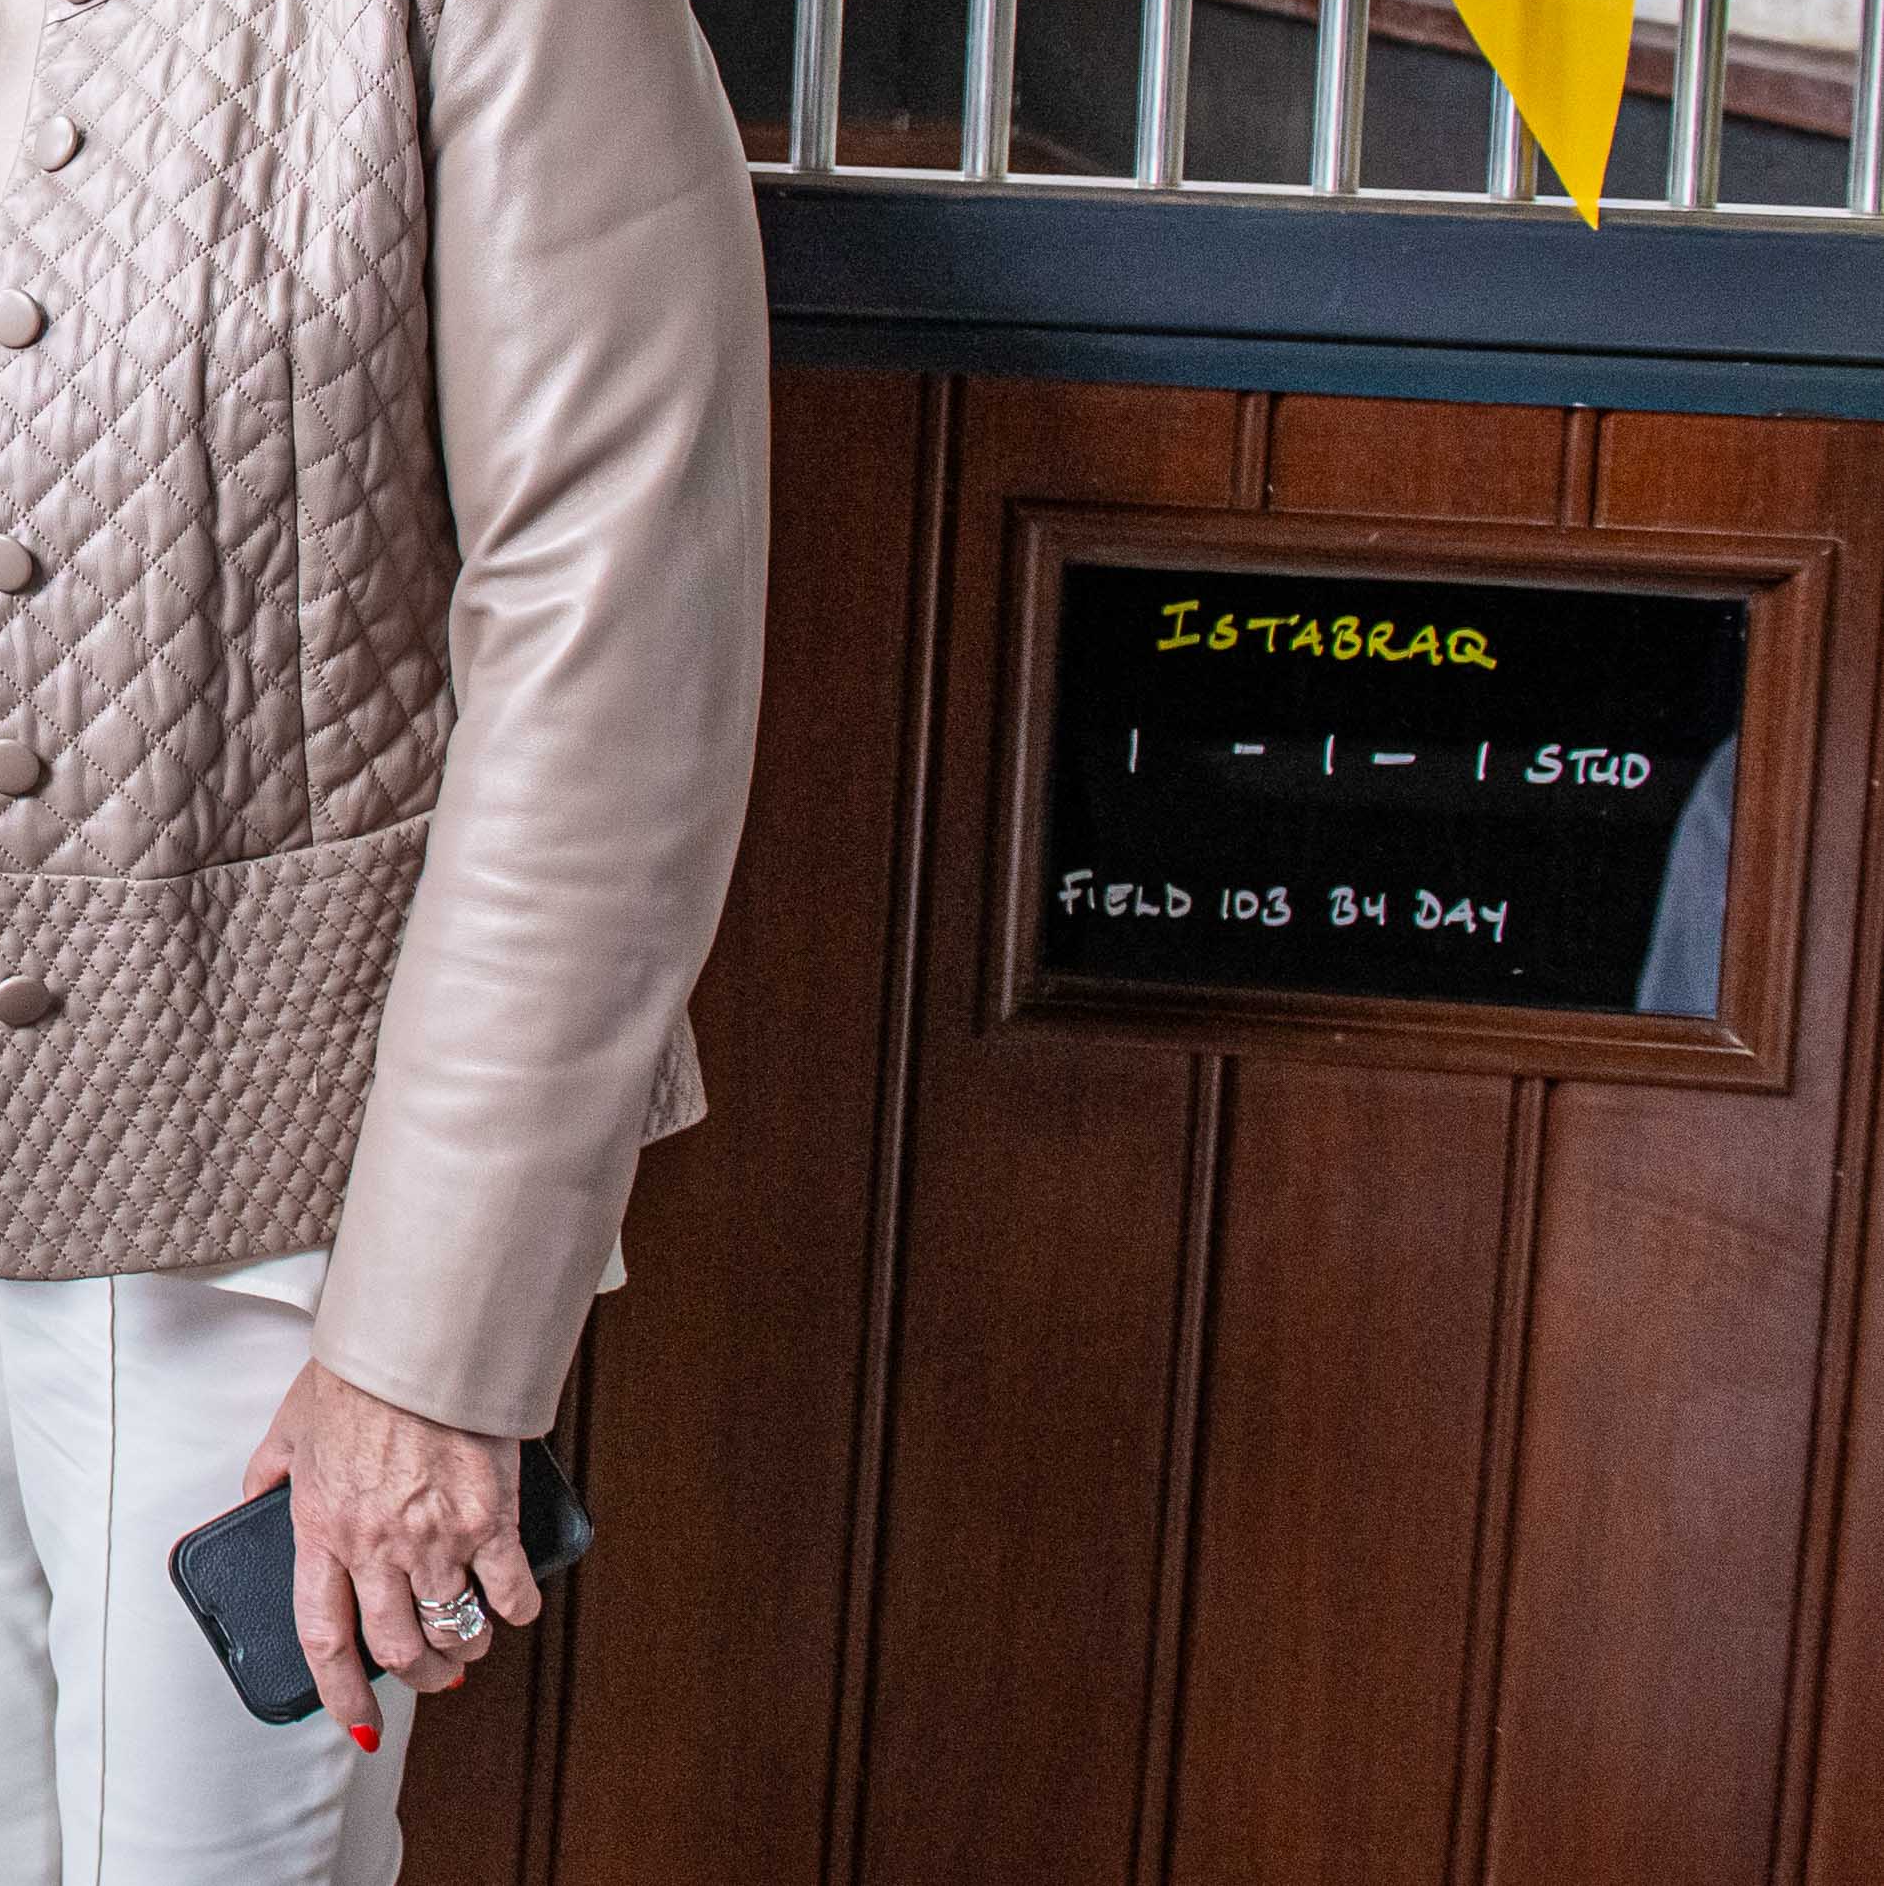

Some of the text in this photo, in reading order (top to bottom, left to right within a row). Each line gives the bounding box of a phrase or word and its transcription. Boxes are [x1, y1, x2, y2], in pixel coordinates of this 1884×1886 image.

[1156, 600, 1498, 670] ISTABRAQ
[1058, 869, 1509, 943] FIELD 103 BY DAY
